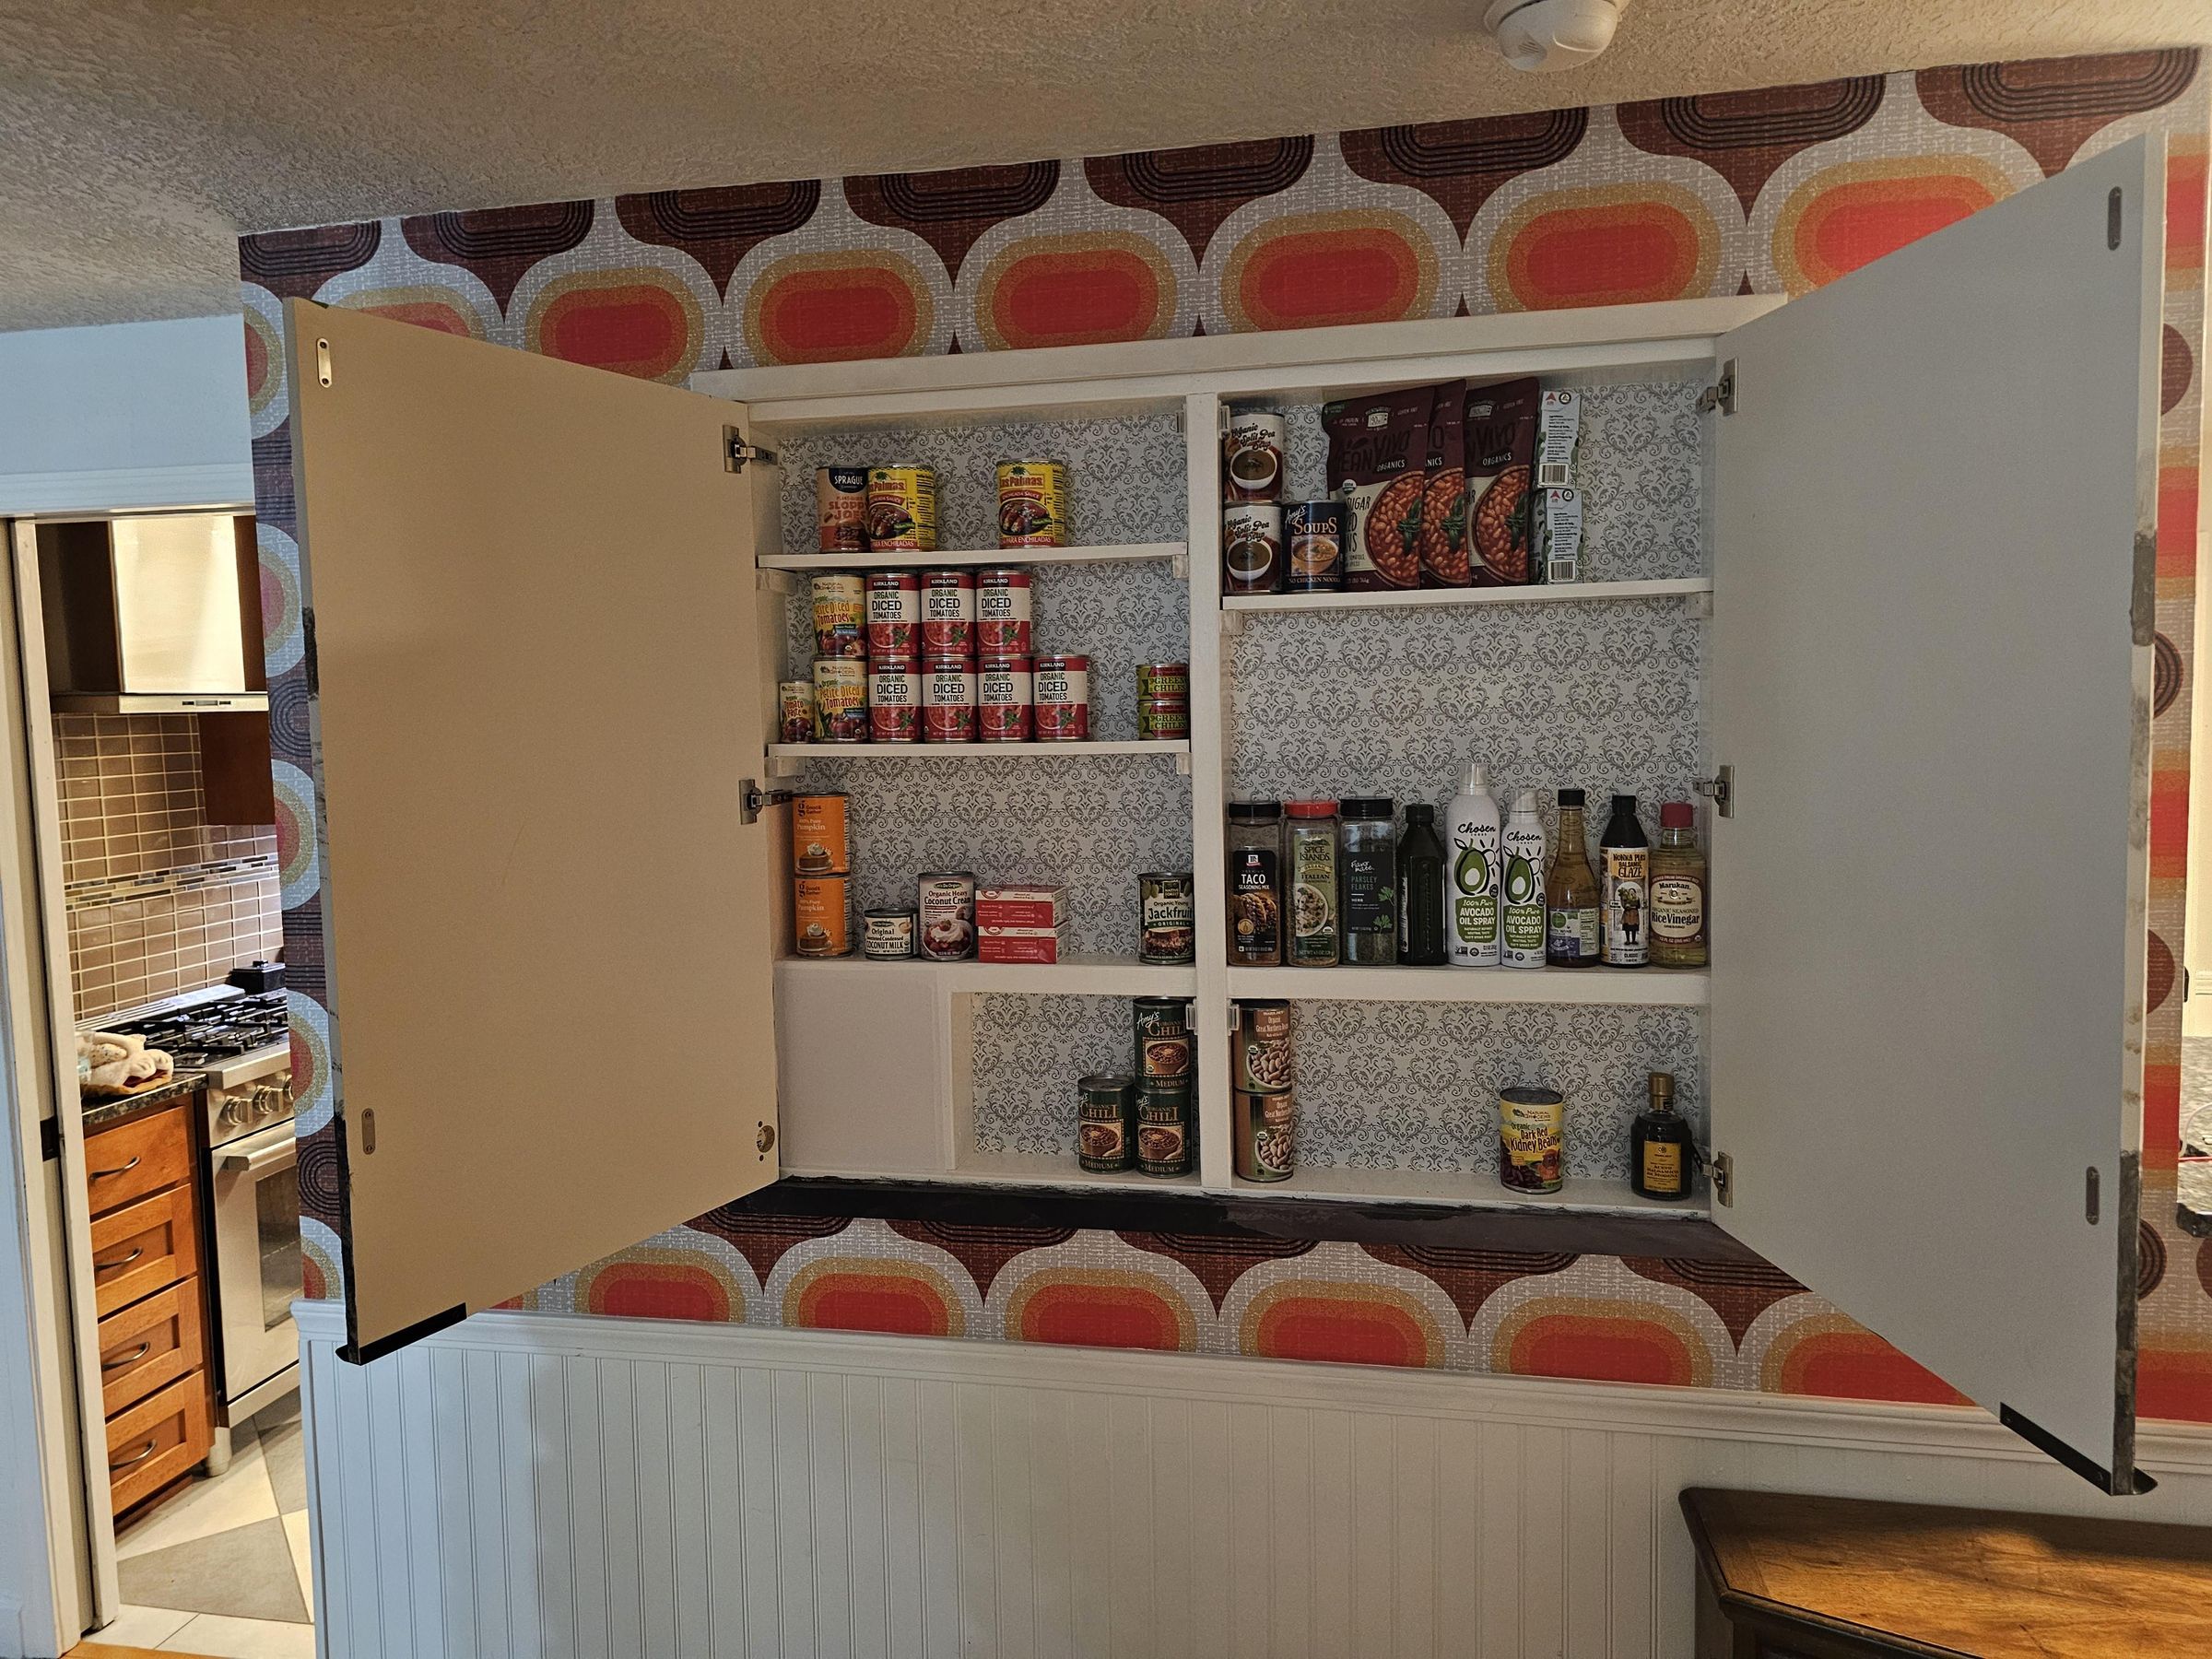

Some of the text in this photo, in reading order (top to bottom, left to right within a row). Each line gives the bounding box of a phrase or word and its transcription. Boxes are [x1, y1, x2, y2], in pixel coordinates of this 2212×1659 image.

[1231, 423, 1258, 438] Organic
[1241, 429, 1276, 447] Split Pea
[1252, 440, 1271, 451] Soup
[1482, 453, 1512, 465] ORGANICS
[1376, 460, 1406, 472] ORGANICS
[834, 475, 864, 485] SPRAGUE
[829, 501, 865, 510] SLOPP
[1347, 496, 1371, 511] SUGAR
[834, 511, 866, 521] JOES
[1285, 505, 1307, 529] Amy's
[1235, 521, 1269, 538] Split Pea
[1294, 517, 1336, 535] SOUPS
[1246, 532, 1265, 542] Soup
[874, 591, 900, 599] ORGANIC
[983, 588, 1008, 596] ORGANIC
[830, 600, 849, 614] Diced
[872, 600, 902, 610] DICED
[929, 598, 960, 608] DICED
[982, 597, 1011, 608] DICED
[818, 613, 849, 627] Tomatoes
[873, 611, 901, 619] TOMATOES
[841, 685, 859, 696] Diced
[877, 684, 908, 694] DICED
[934, 684, 965, 694] DICED
[983, 683, 1013, 693] DICED
[1038, 682, 1067, 692] DICED
[783, 700, 805, 710] Tomato
[826, 697, 859, 710] Tomatoes
[787, 708, 801, 718] Paste
[797, 823, 826, 831] Pumpkin
[1458, 822, 1496, 833] Chosen
[1507, 831, 1542, 841] Chosen
[1300, 853, 1330, 861] ISLANDS
[1618, 867, 1642, 877] GLAZE
[1241, 874, 1266, 884] TACO
[798, 904, 824, 912] Pumpkin
[1460, 908, 1494, 916] AVOCADO
[1459, 917, 1495, 925] OIL SPRAY
[1506, 915, 1541, 924] AVOCADO
[1652, 912, 1700, 925] Rice Vinegar
[1505, 925, 1517, 934] OIL
[1518, 925, 1542, 934] SPRAY
[1136, 1011, 1159, 1030] Amy's
[1256, 1024, 1266, 1032] Great
[1156, 1079, 1185, 1088] MEDIUM
[1080, 1104, 1118, 1119] CHILI
[1139, 1105, 1180, 1122] CHILI
[1265, 1110, 1275, 1118] Great
[1521, 1126, 1548, 1139] Dark Red
[1510, 1135, 1558, 1153] Kidney Beans
[1086, 1160, 1113, 1169] MEDIUM
[1144, 1163, 1175, 1172] MEDIUM
